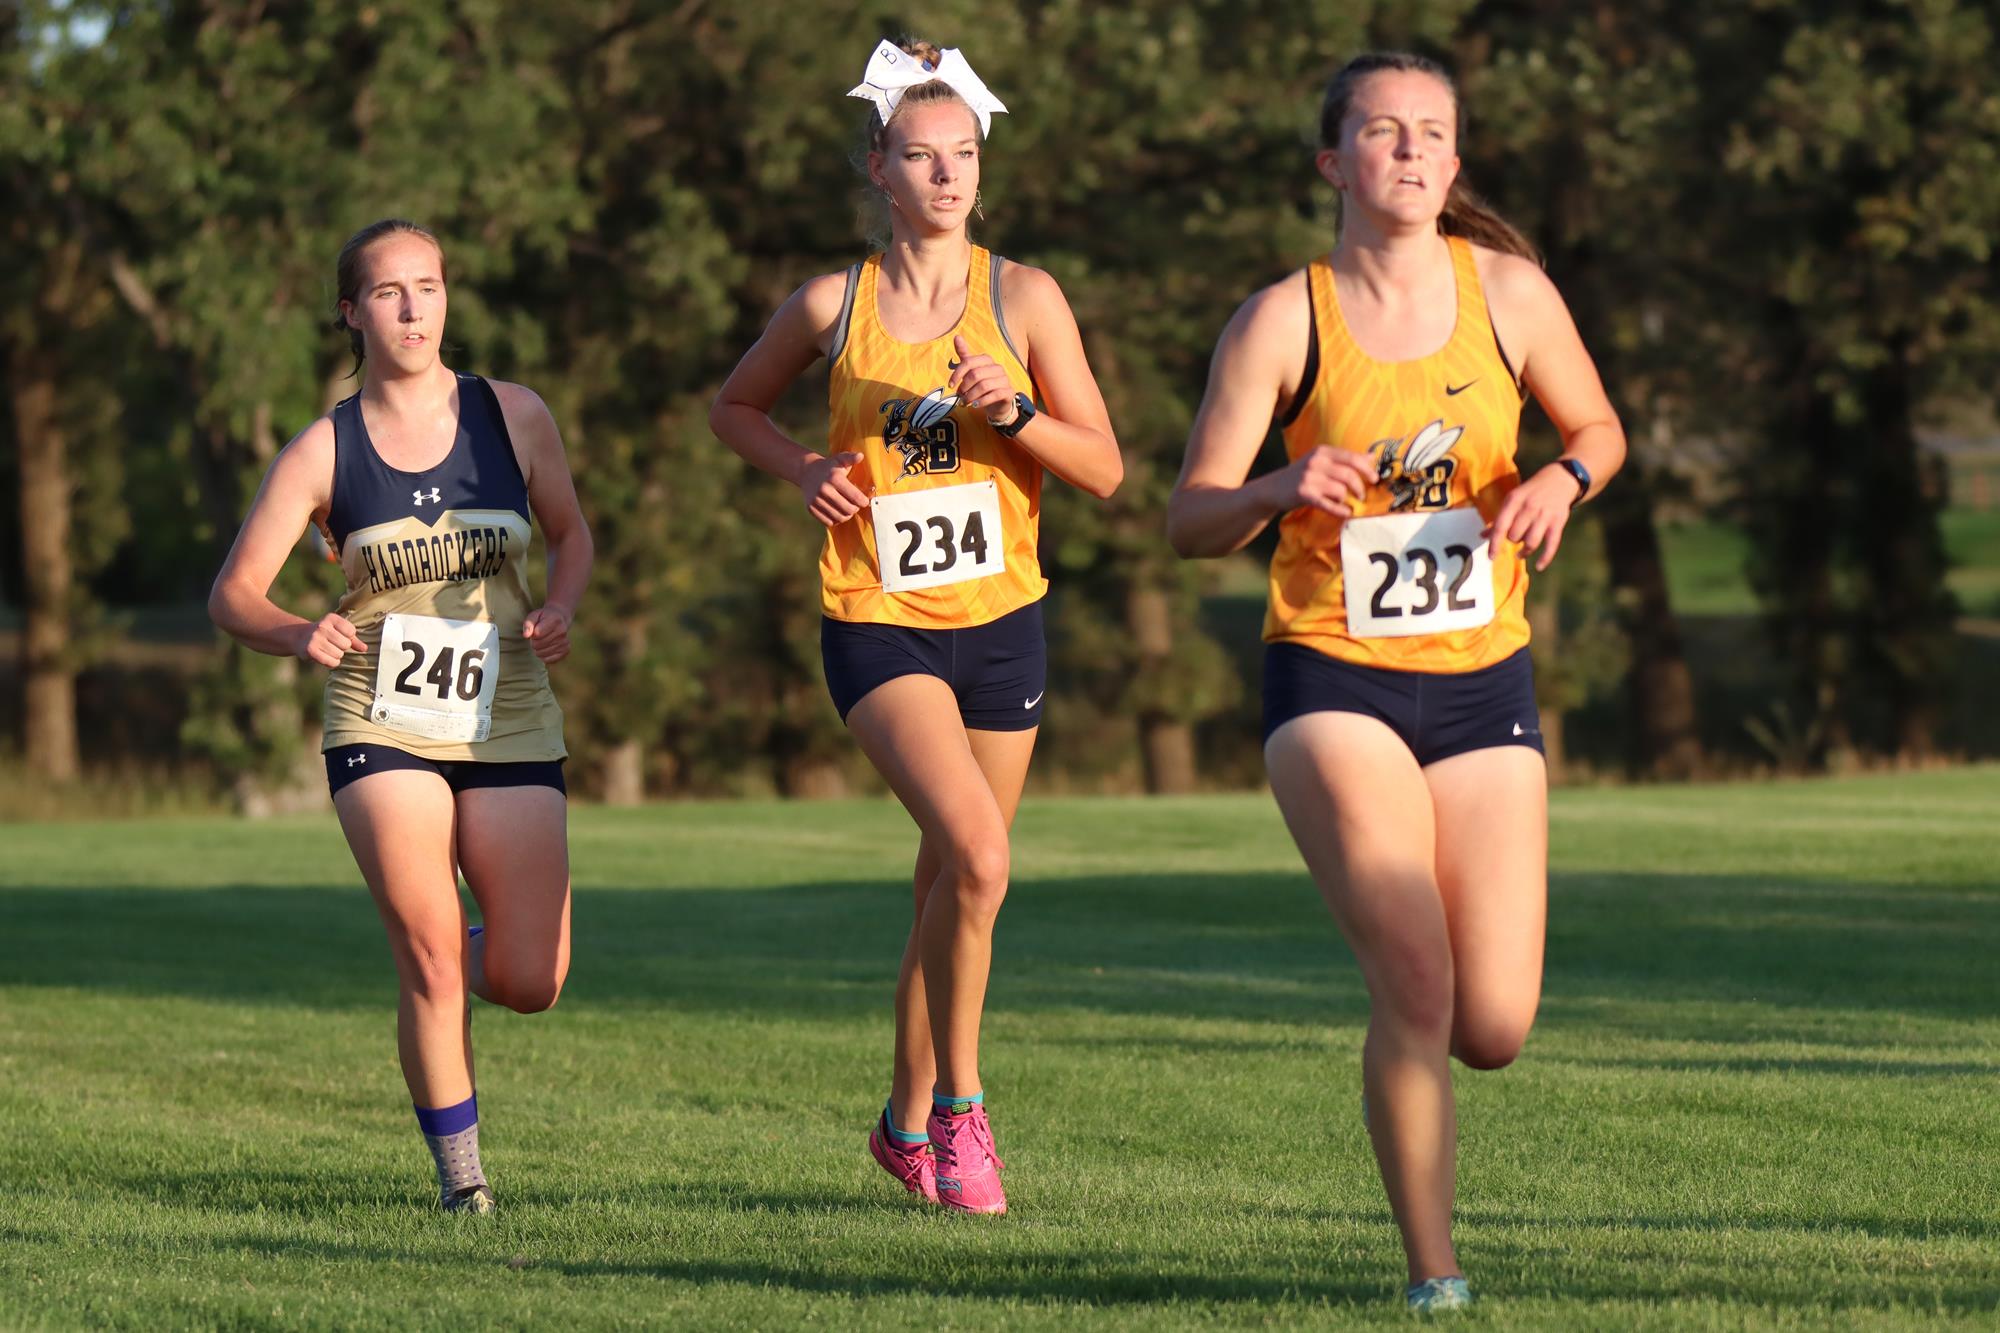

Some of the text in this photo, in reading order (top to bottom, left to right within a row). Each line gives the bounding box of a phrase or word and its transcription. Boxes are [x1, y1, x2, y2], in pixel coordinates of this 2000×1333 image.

[880, 48, 898, 65] B
[924, 417, 960, 474] B
[1416, 453, 1459, 513] B
[361, 527, 508, 593] HARDROCKERS
[895, 511, 987, 576] 234
[1368, 544, 1476, 618] 232
[394, 641, 485, 701] 246
